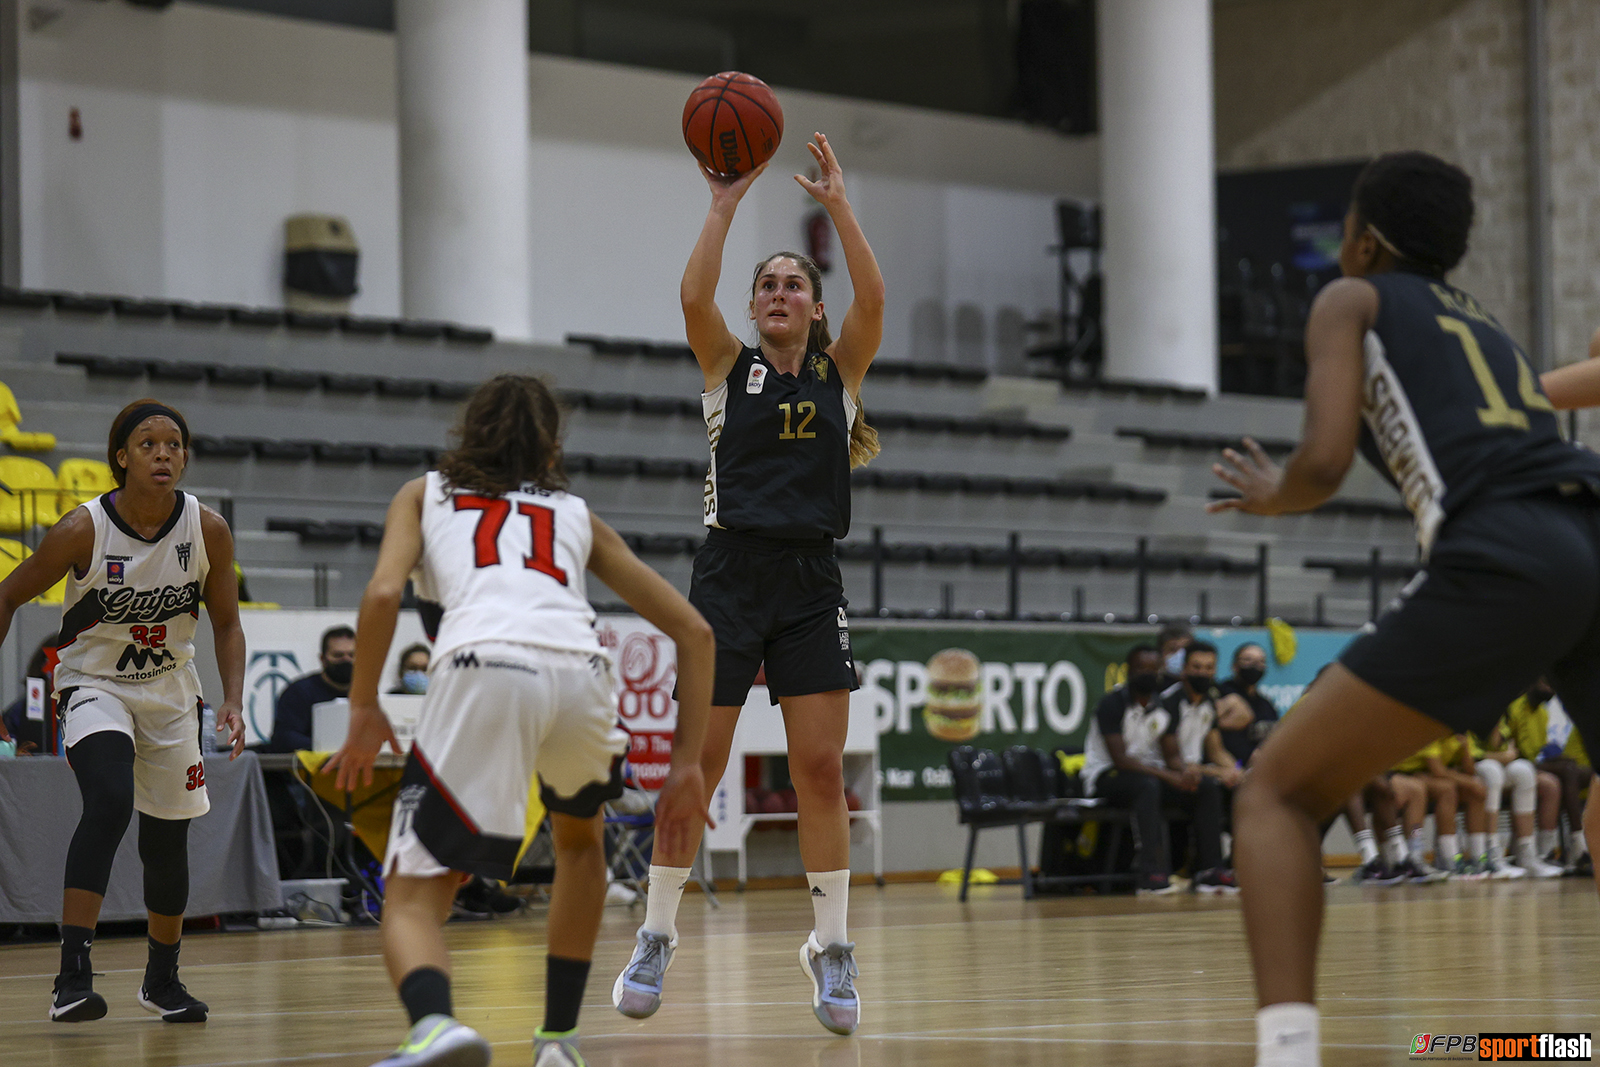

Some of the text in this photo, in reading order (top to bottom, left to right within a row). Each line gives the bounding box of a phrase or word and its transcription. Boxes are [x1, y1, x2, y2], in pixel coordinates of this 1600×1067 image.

[778, 400, 816, 439] 12
[453, 494, 568, 587] 71
[129, 623, 168, 648] 32
[185, 760, 205, 791] 32
